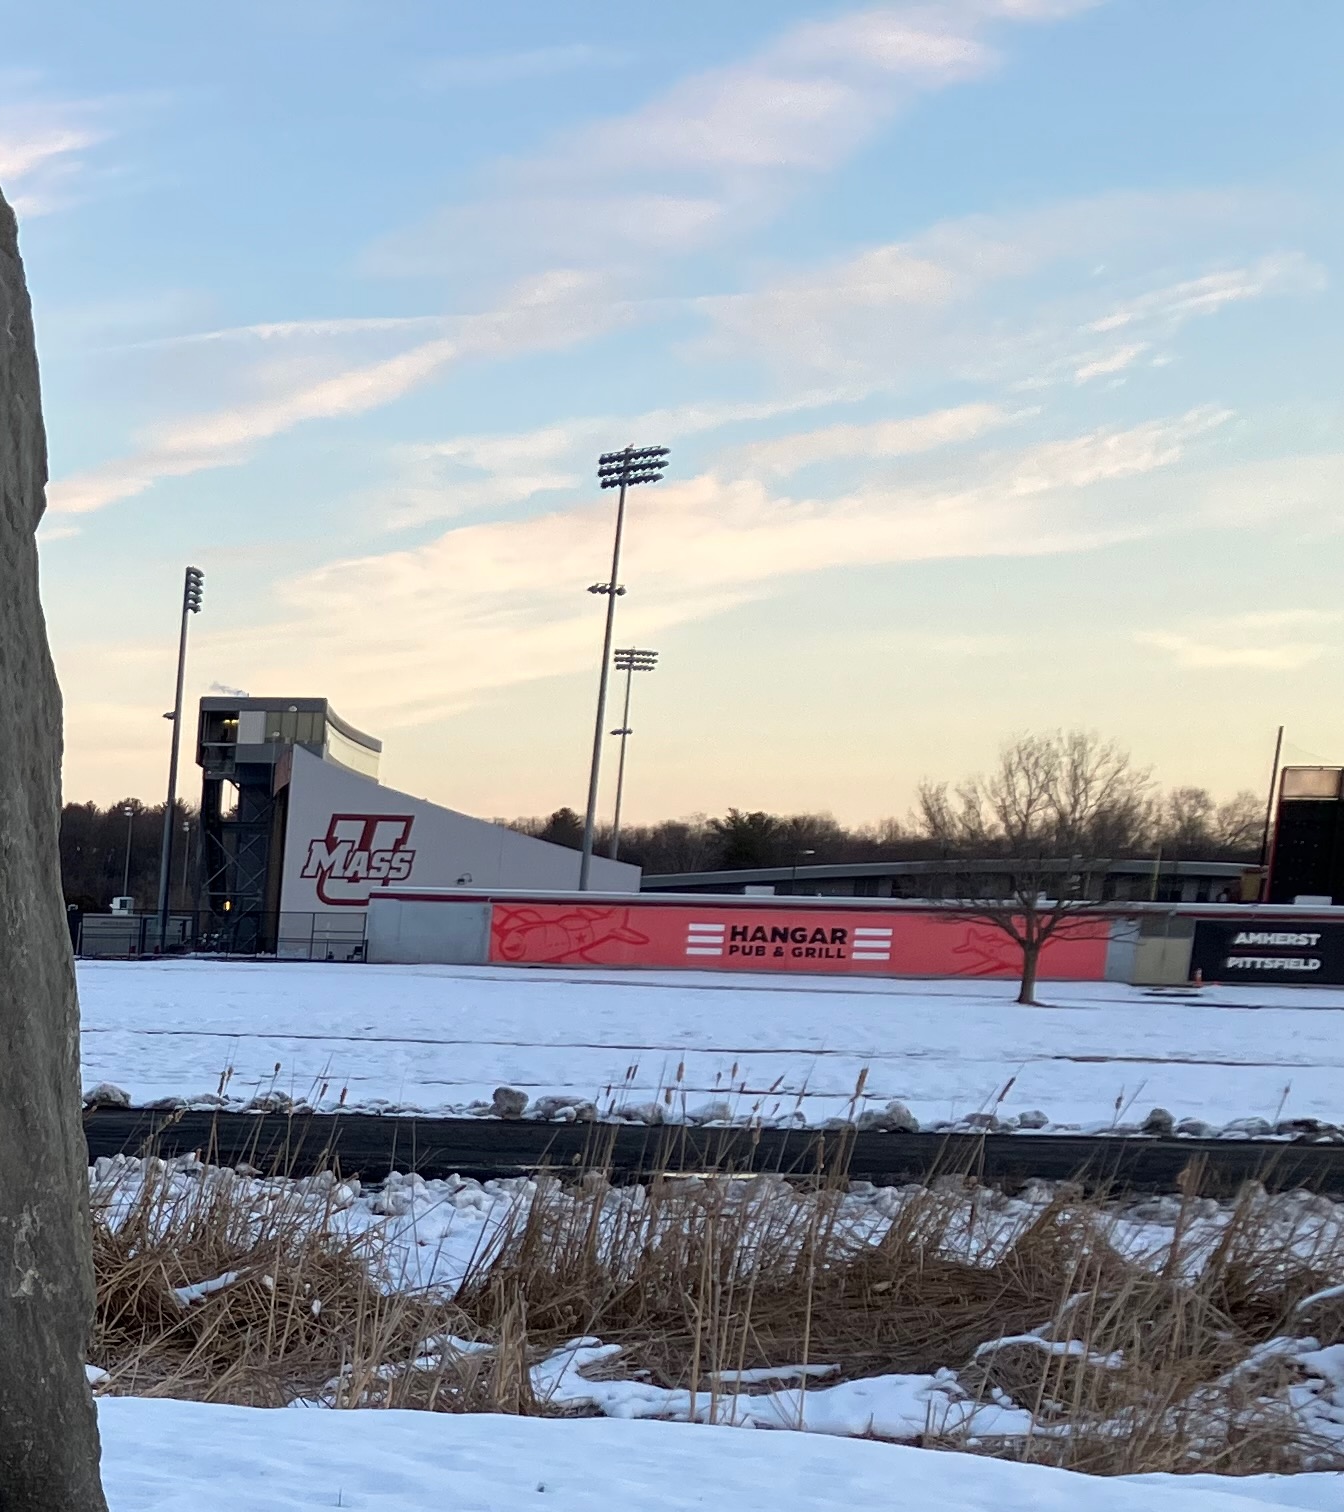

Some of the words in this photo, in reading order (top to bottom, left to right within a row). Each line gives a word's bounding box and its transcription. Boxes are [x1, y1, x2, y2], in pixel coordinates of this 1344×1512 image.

[730, 925, 848, 945] HANGAR
[1234, 932, 1321, 946] AMHERST
[729, 945, 766, 957] PUB
[773, 946, 785, 958] &
[791, 947, 847, 959] GRILL
[1226, 957, 1321, 970] PITTSFIELD
